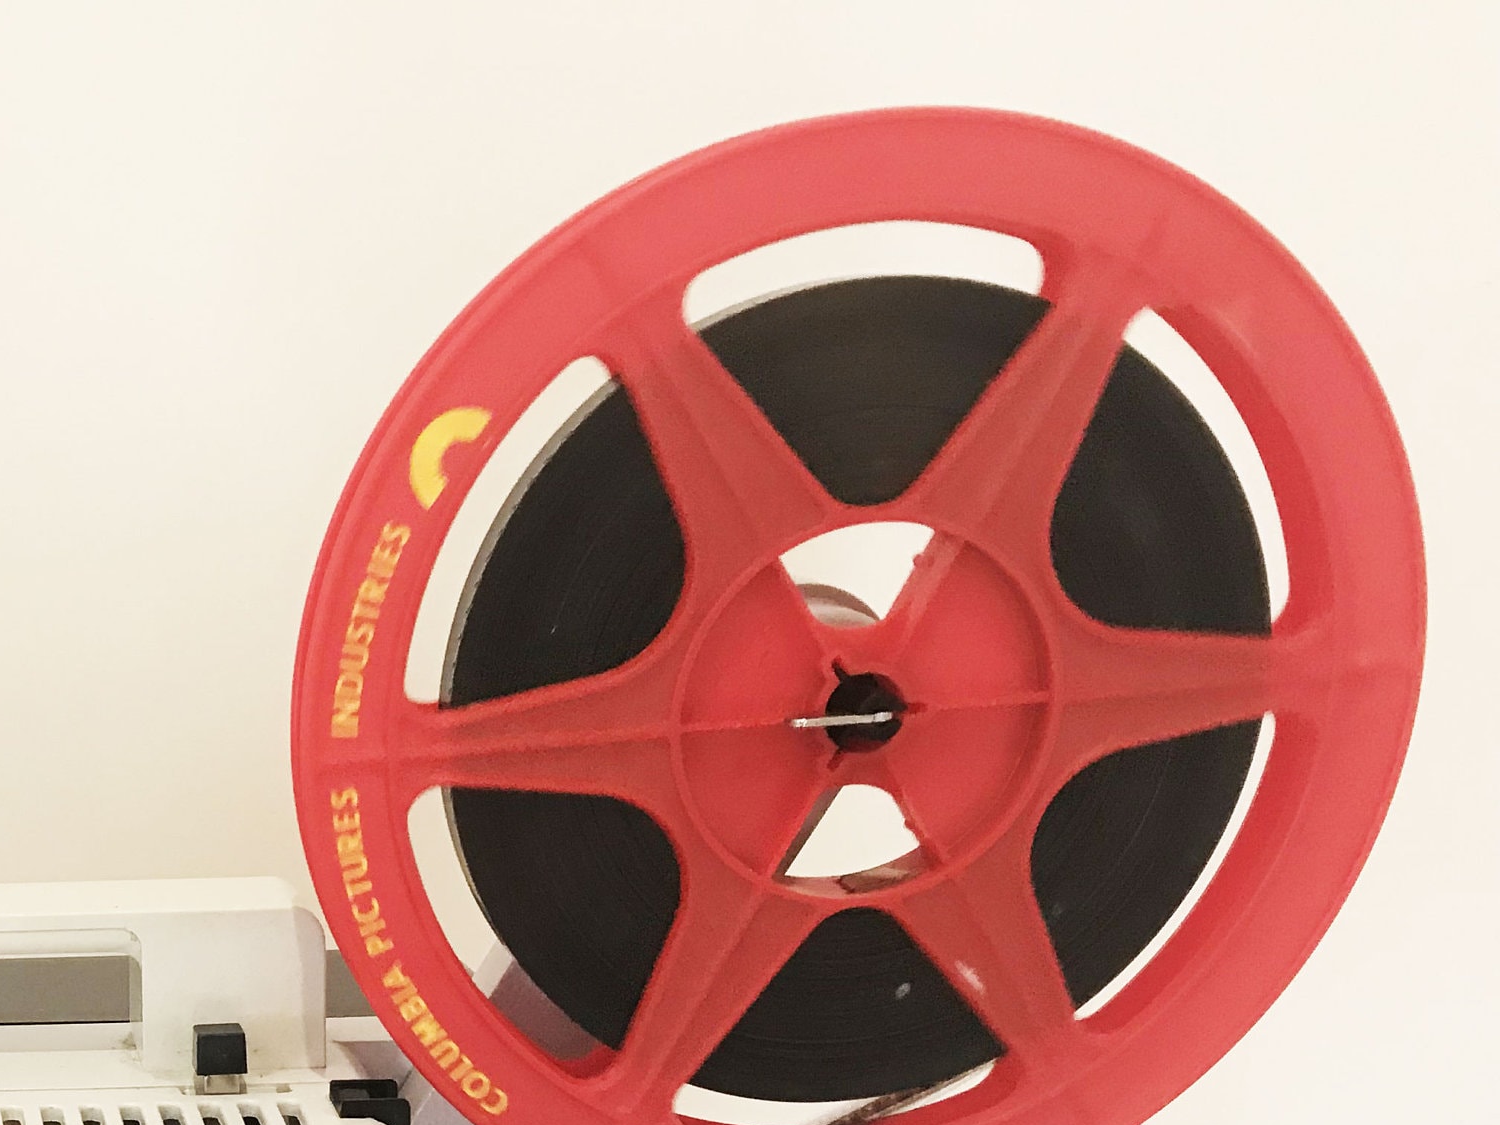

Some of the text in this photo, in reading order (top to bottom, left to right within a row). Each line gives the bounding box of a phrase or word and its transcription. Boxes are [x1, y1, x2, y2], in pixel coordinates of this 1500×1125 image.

[330, 520, 509, 1116] COLUMBIA PICTURES INDUSTRIES
